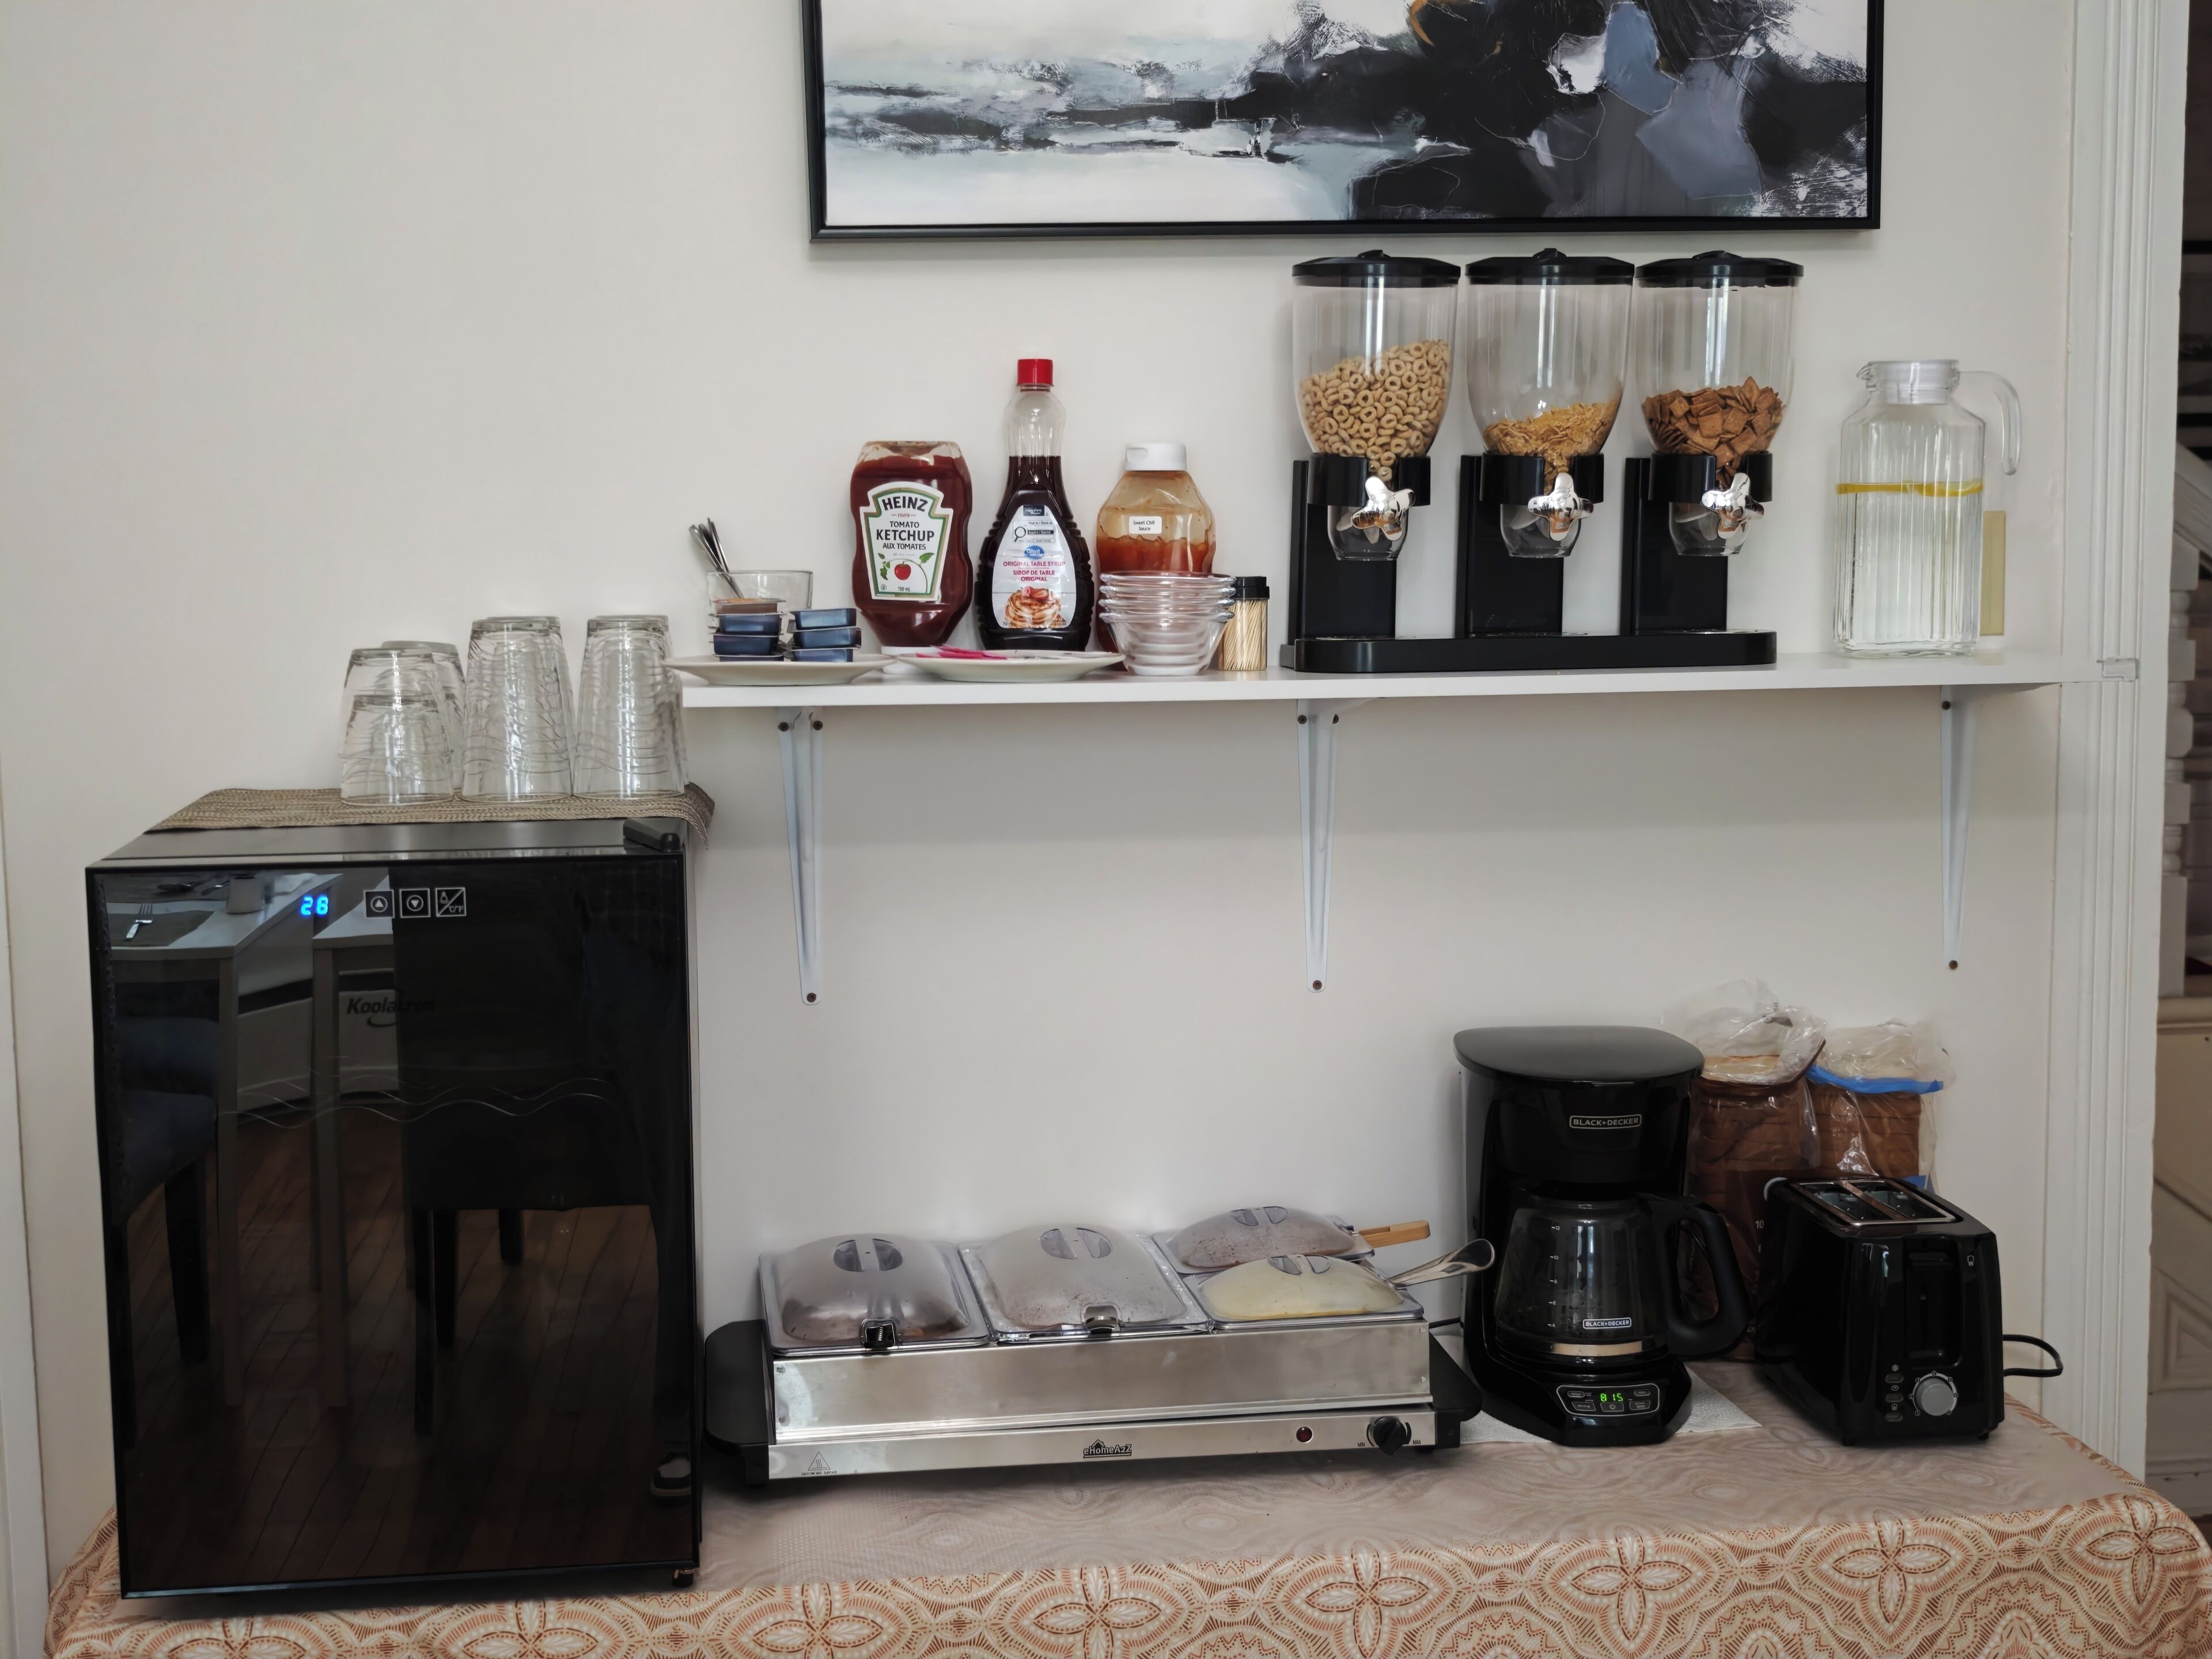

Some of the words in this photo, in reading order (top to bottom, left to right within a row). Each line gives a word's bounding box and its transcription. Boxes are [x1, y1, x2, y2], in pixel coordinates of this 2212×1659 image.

[881, 495, 928, 512] HEINZ
[876, 529, 935, 542] KETCHUP
[1573, 1118, 1639, 1126] BLACK+DECKER
[1585, 1319, 1630, 1327] BLACK+DECKER
[1083, 1444, 1132, 1456] eHomeA2Z
